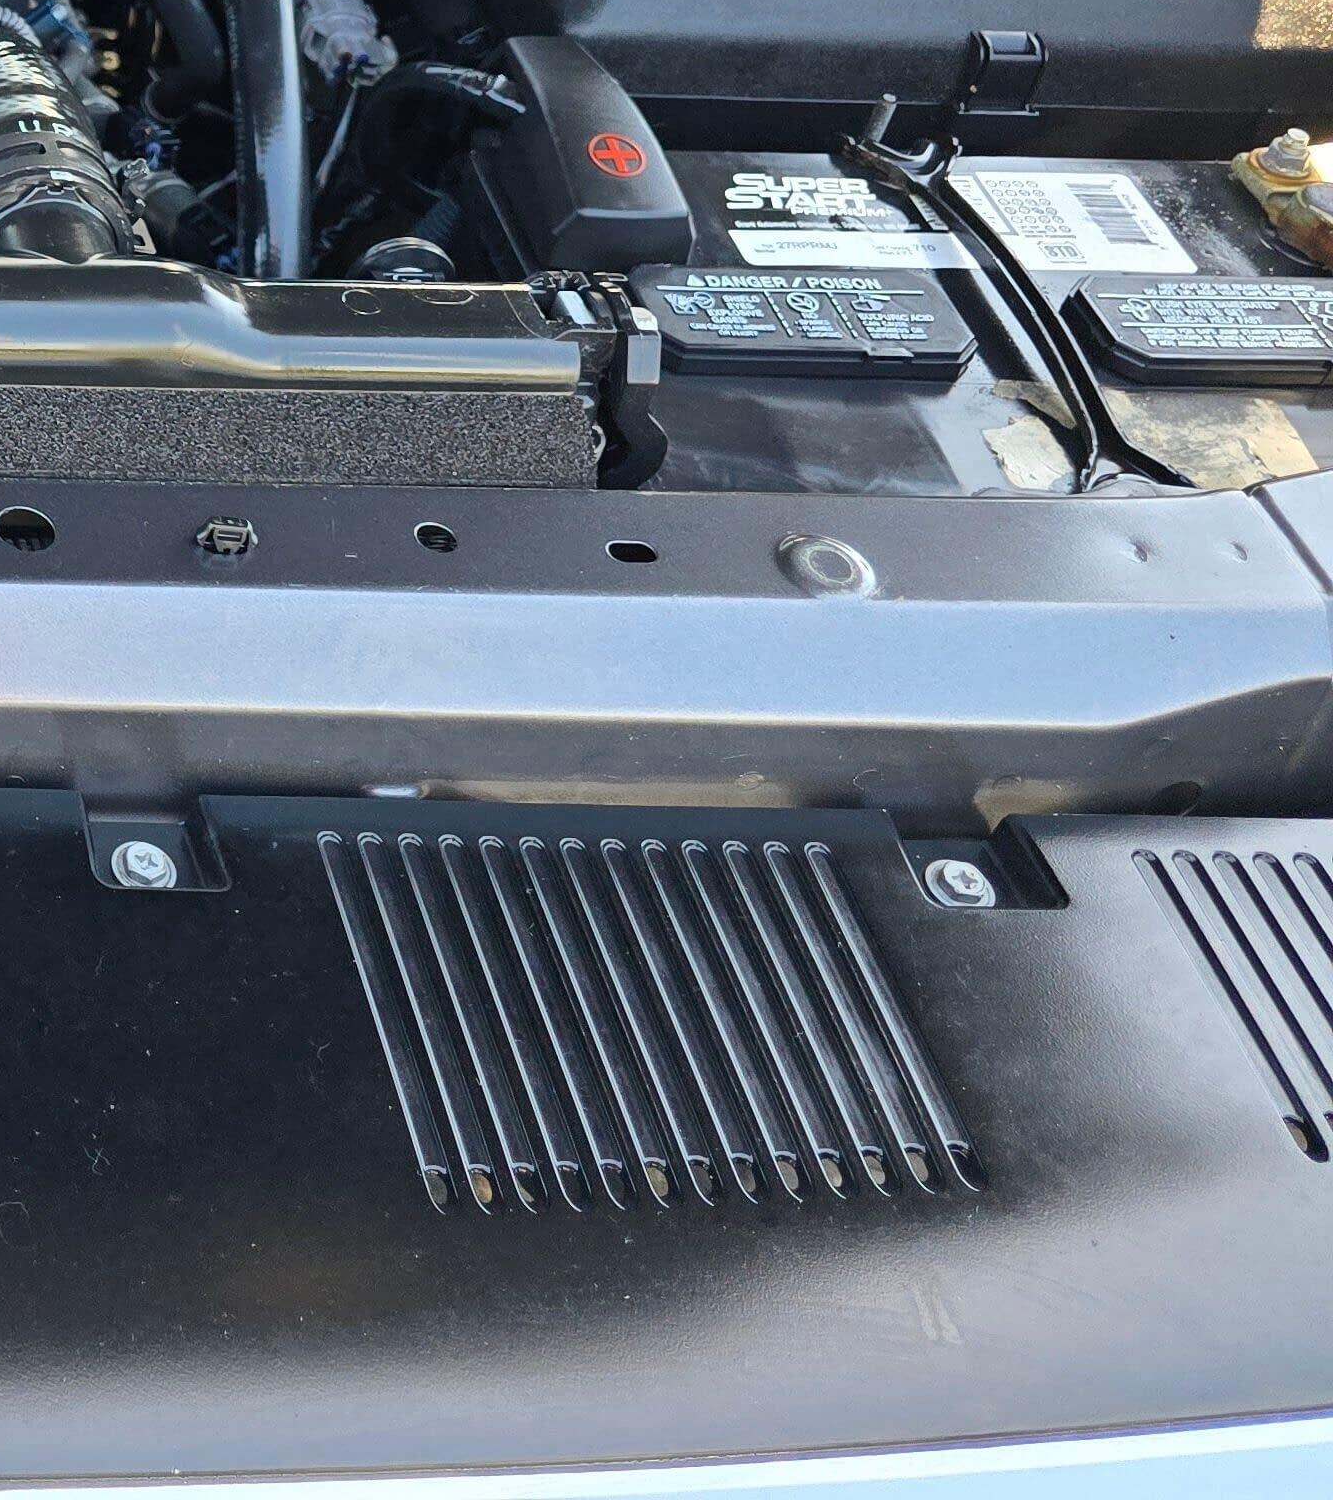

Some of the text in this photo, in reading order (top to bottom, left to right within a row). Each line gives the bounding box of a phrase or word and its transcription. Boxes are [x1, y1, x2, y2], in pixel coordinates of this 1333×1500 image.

[732, 173, 870, 194] SUPER
[724, 187, 877, 210] START
[703, 275, 789, 289] DANGER
[805, 276, 882, 290] POISON
[1150, 300, 1184, 308] FLUSH
[1184, 301, 1214, 309] EYES
[706, 309, 765, 318] EXPLOSIVE
[1157, 308, 1185, 317] WITH
[857, 313, 935, 323] SULFURIC ACID
[1207, 316, 1235, 324] HELP
